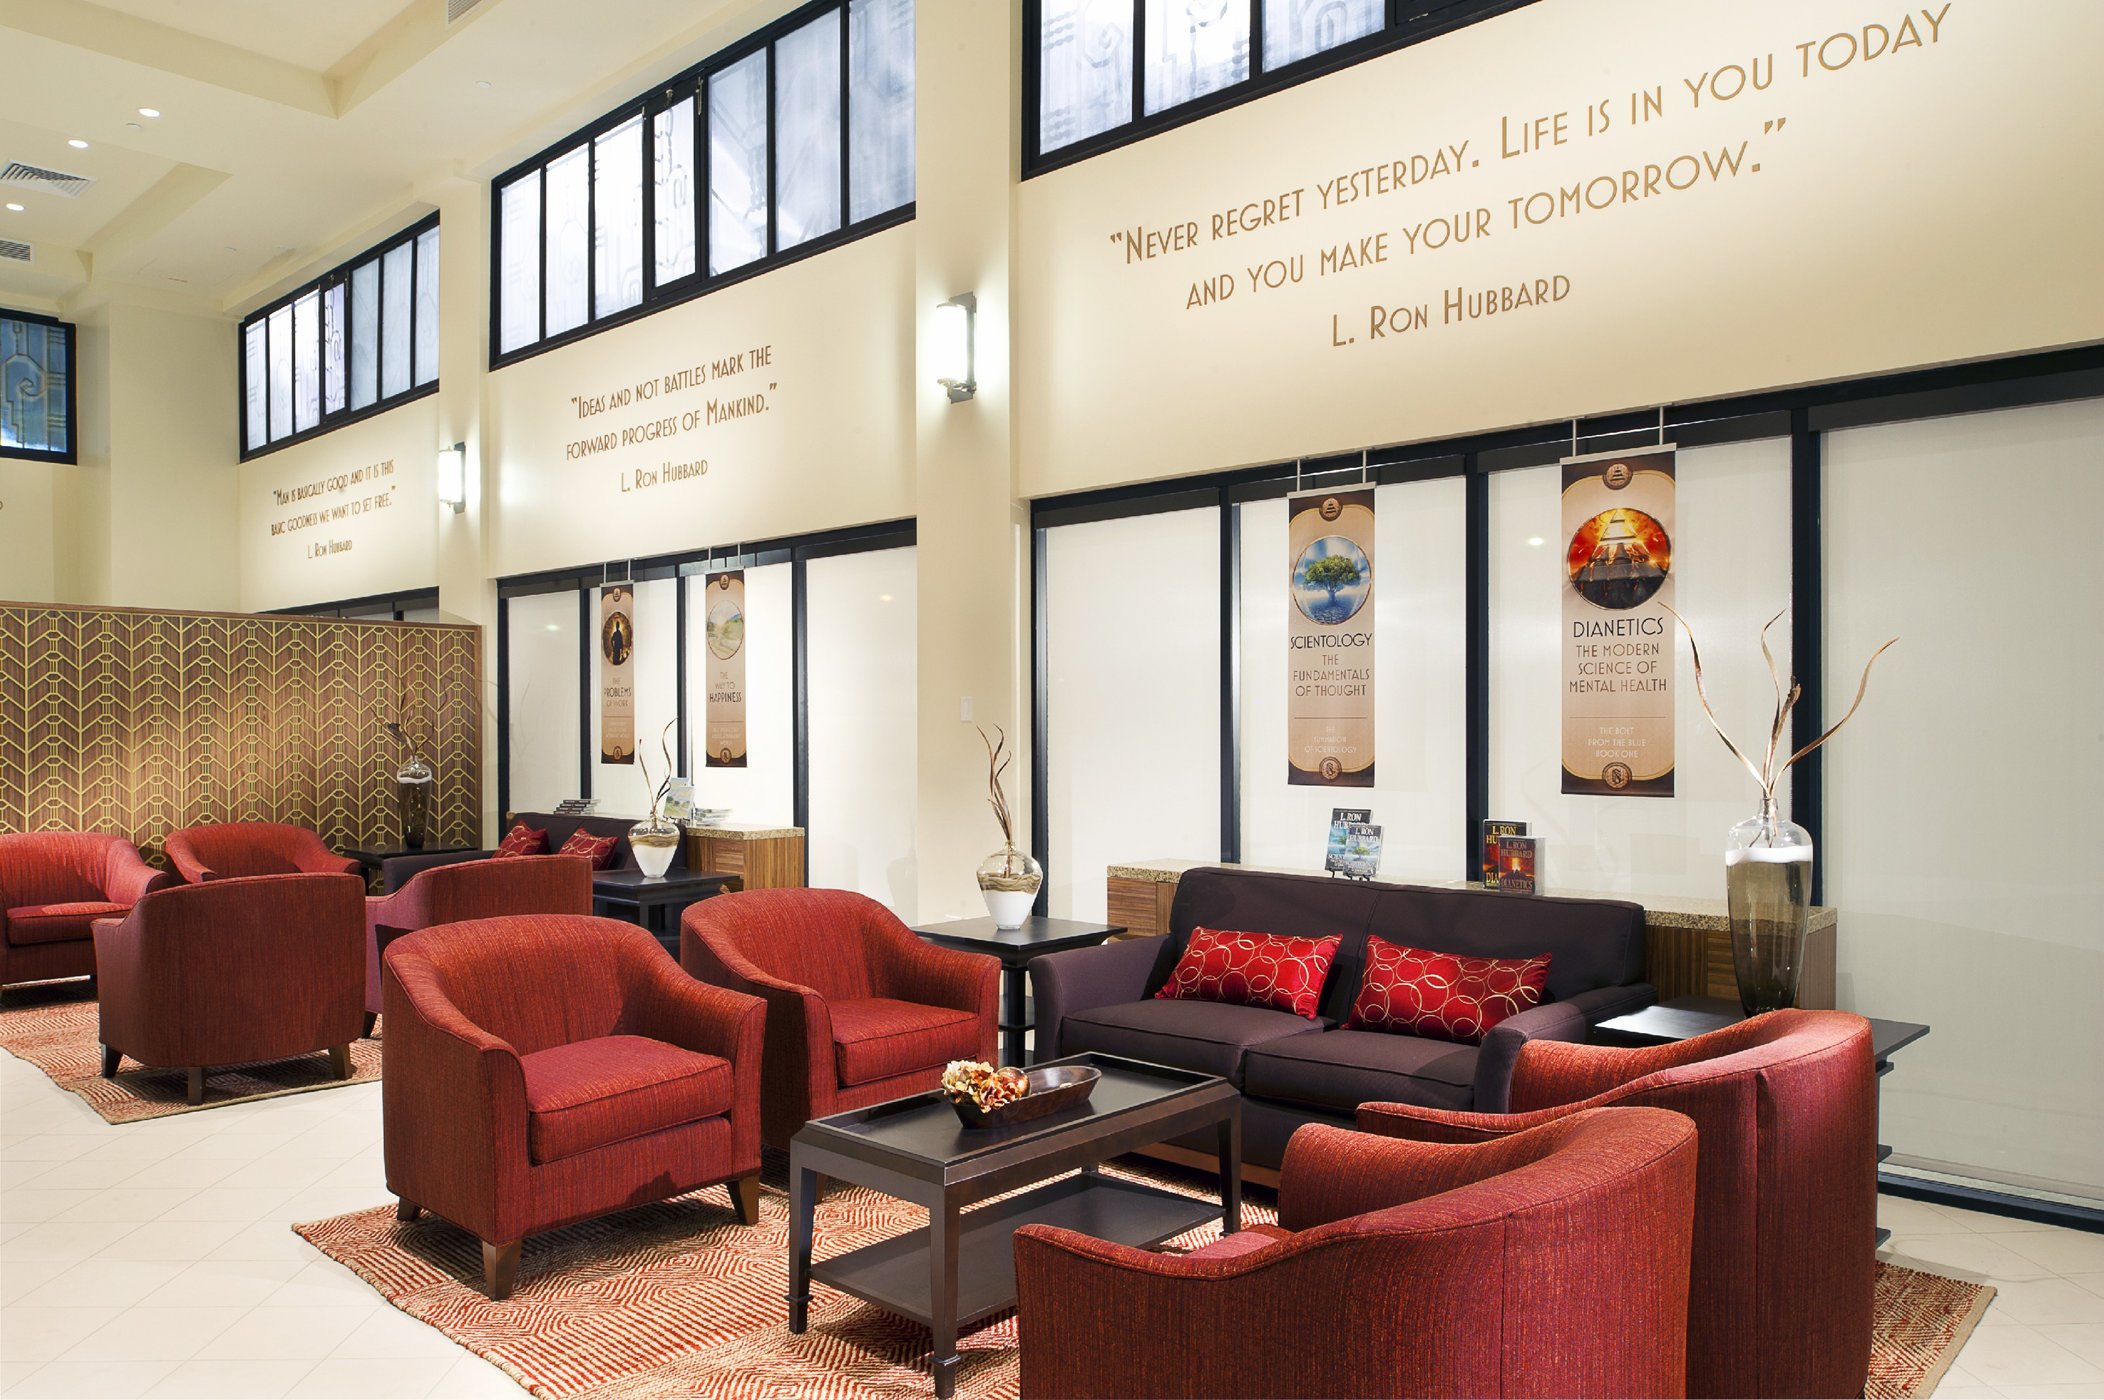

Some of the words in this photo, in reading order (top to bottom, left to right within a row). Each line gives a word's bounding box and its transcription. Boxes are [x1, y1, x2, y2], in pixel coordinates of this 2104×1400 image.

[1211, 188, 1305, 241] REGRET
[1316, 139, 1480, 211] YESTERDAY.
[1501, 111, 1568, 159] LIFE
[1588, 98, 1611, 137] IS
[1631, 85, 1663, 126] IN
[1683, 53, 1774, 109] YOU
[1795, 2, 1952, 78] TODAY
[1186, 273, 1235, 310] AND
[1246, 254, 1304, 294] YOU
[1320, 232, 1389, 277] MAKE
[1402, 207, 1491, 256] YOUR
[1331, 314, 1356, 348] L.
[1369, 304, 1429, 340] RON
[1443, 273, 1571, 325] HUBBARD
[609, 388, 631, 412] AND
[636, 378, 660, 403] NOT
[664, 364, 706, 395] BATTLES
[712, 353, 744, 381] MARK
[749, 345, 772, 370] THE
[566, 431, 617, 462] FORWARD
[622, 416, 678, 448] PROGRESS
[682, 410, 700, 433] OF
[297, 480, 326, 501] BASICALLY
[327, 474, 349, 493] GOOD
[351, 469, 364, 486] AND
[366, 466, 371, 481] IT
[373, 463, 379, 479] IS
[381, 459, 394, 477] THIS
[621, 472, 631, 493] L.
[635, 468, 658, 490] RON
[662, 459, 709, 485] HUBBARD
[271, 521, 286, 537] BASIC
[287, 510, 318, 532] GOODNESS
[319, 509, 330, 524] WE
[331, 503, 350, 521] WANT
[351, 500, 361, 516] TO
[362, 497, 372, 513] SET
[1573, 617, 1664, 638] DIANETICS
[1290, 633, 1373, 650] SCIENTOLOGY
[1576, 644, 1598, 658] THE
[1603, 642, 1660, 657] MODERN
[1322, 654, 1339, 666] THE
[1578, 661, 1632, 675] SCIENCE
[1637, 660, 1657, 674] OF
[1293, 668, 1370, 681] FUNDAMENTALS
[603, 687, 632, 697] PROBLEMS
[1295, 685, 1312, 697] OF
[1315, 684, 1367, 697] THOUGHT
[1569, 679, 1616, 693] MENTAL
[1620, 678, 1667, 692] HEALTH
[709, 692, 742, 703] HAPPINESS
[1587, 738, 1610, 747] FROM
[1612, 738, 1627, 747] THE
[1595, 749, 1619, 758] BOOK
[1620, 750, 1639, 759] ONE
[1346, 813, 1362, 822] RON
[1500, 825, 1517, 836] RON
